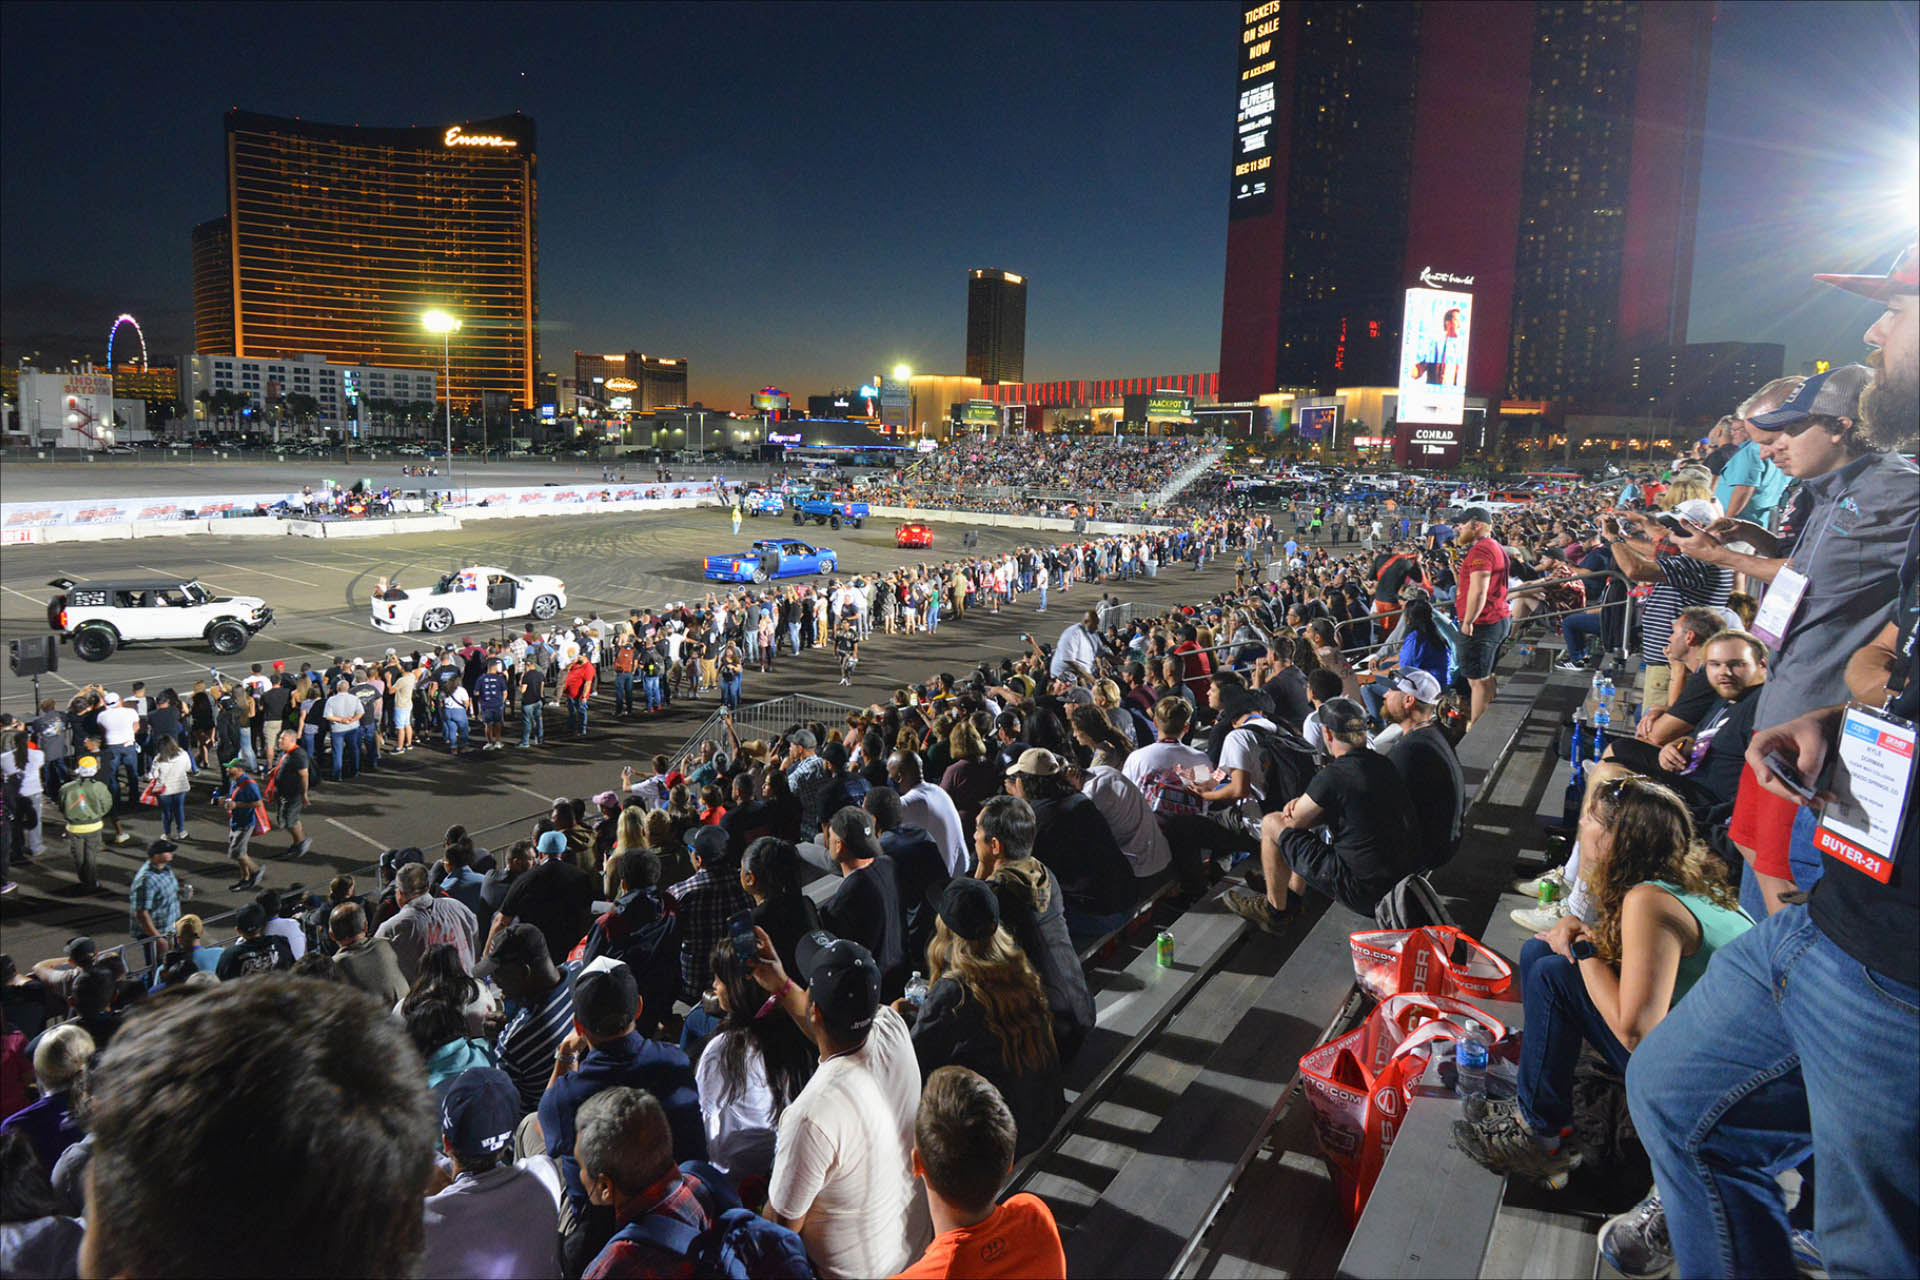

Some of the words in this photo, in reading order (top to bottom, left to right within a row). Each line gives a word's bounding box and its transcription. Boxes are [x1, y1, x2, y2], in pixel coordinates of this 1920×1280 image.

[1245, 0, 1280, 24] TICKETS
[1243, 27, 1256, 43] ON
[1257, 17, 1280, 38] SALE
[1249, 39, 1271, 59] NOW
[444, 126, 518, 147] Encore
[1236, 162, 1250, 176] DEC
[1250, 160, 1257, 172] 11
[1257, 155, 1272, 170] SAT
[1415, 429, 1454, 440] CONRAD
[1821, 833, 1882, 874] BUYER-21
